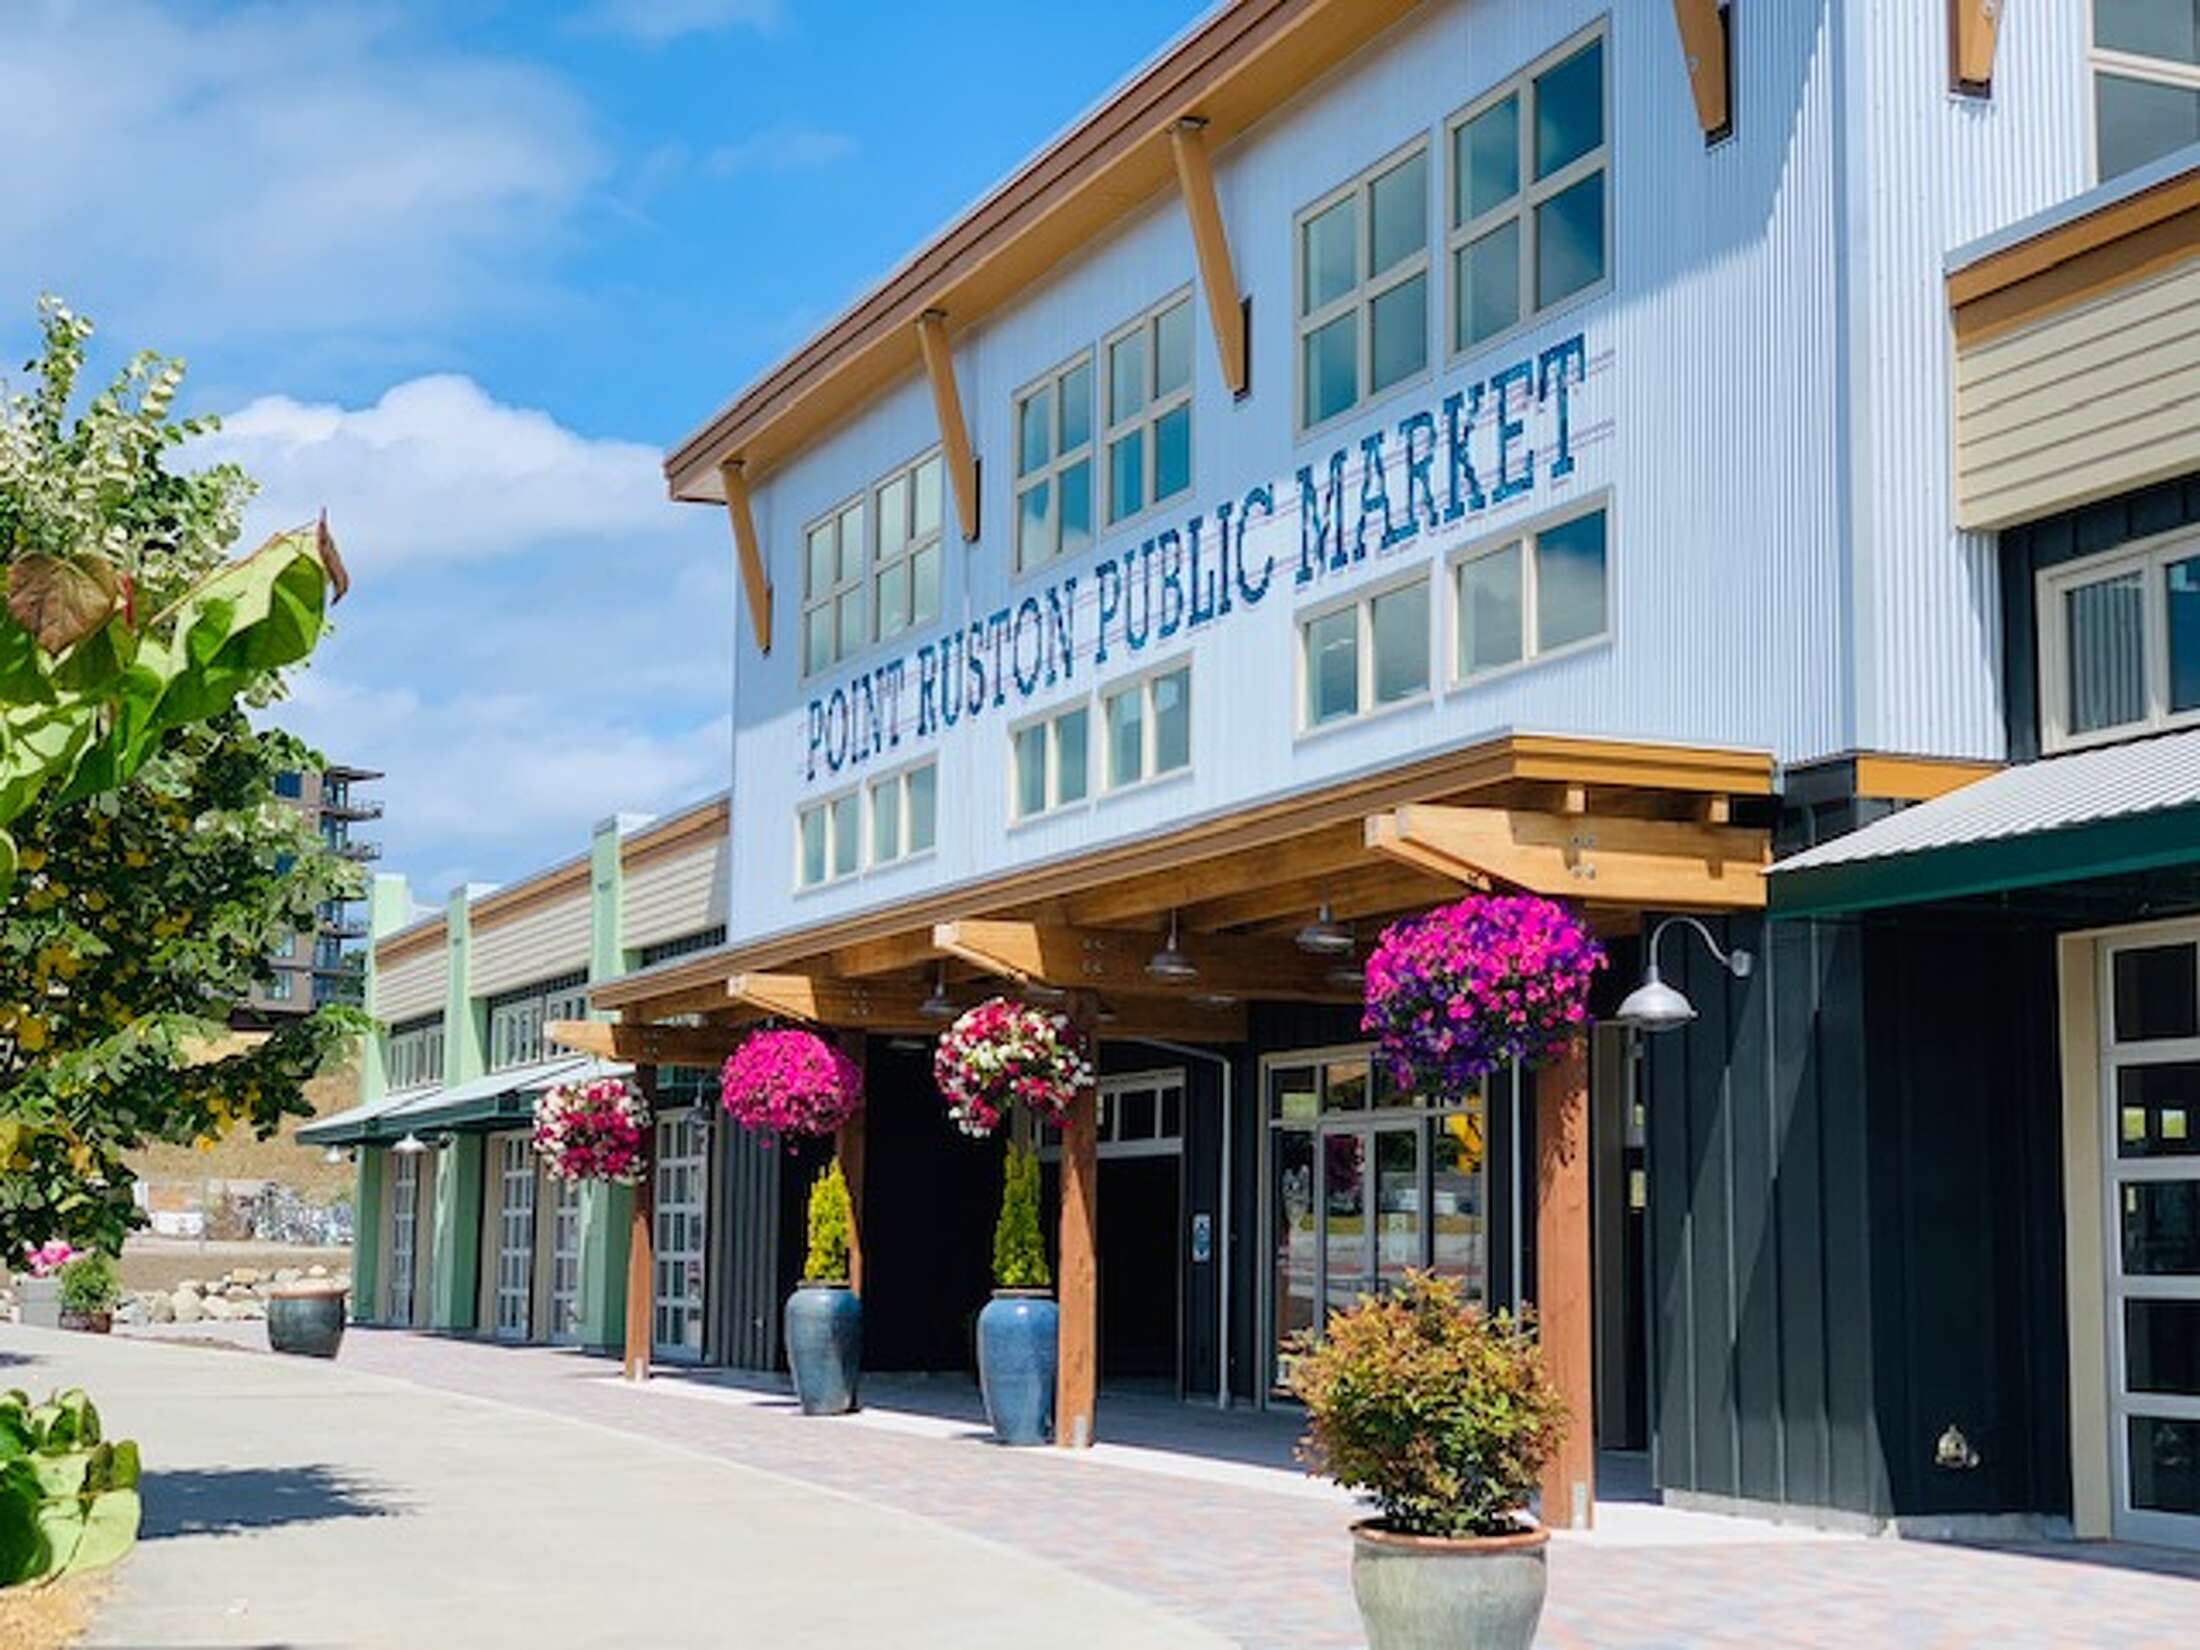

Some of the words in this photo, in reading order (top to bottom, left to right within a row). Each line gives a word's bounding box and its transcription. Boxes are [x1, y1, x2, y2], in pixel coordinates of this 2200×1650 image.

[806, 659, 904, 781] POINT
[917, 577, 1076, 735] RUSTON
[1095, 483, 1273, 663] PUBLIC
[1296, 333, 1585, 584] MARKET
